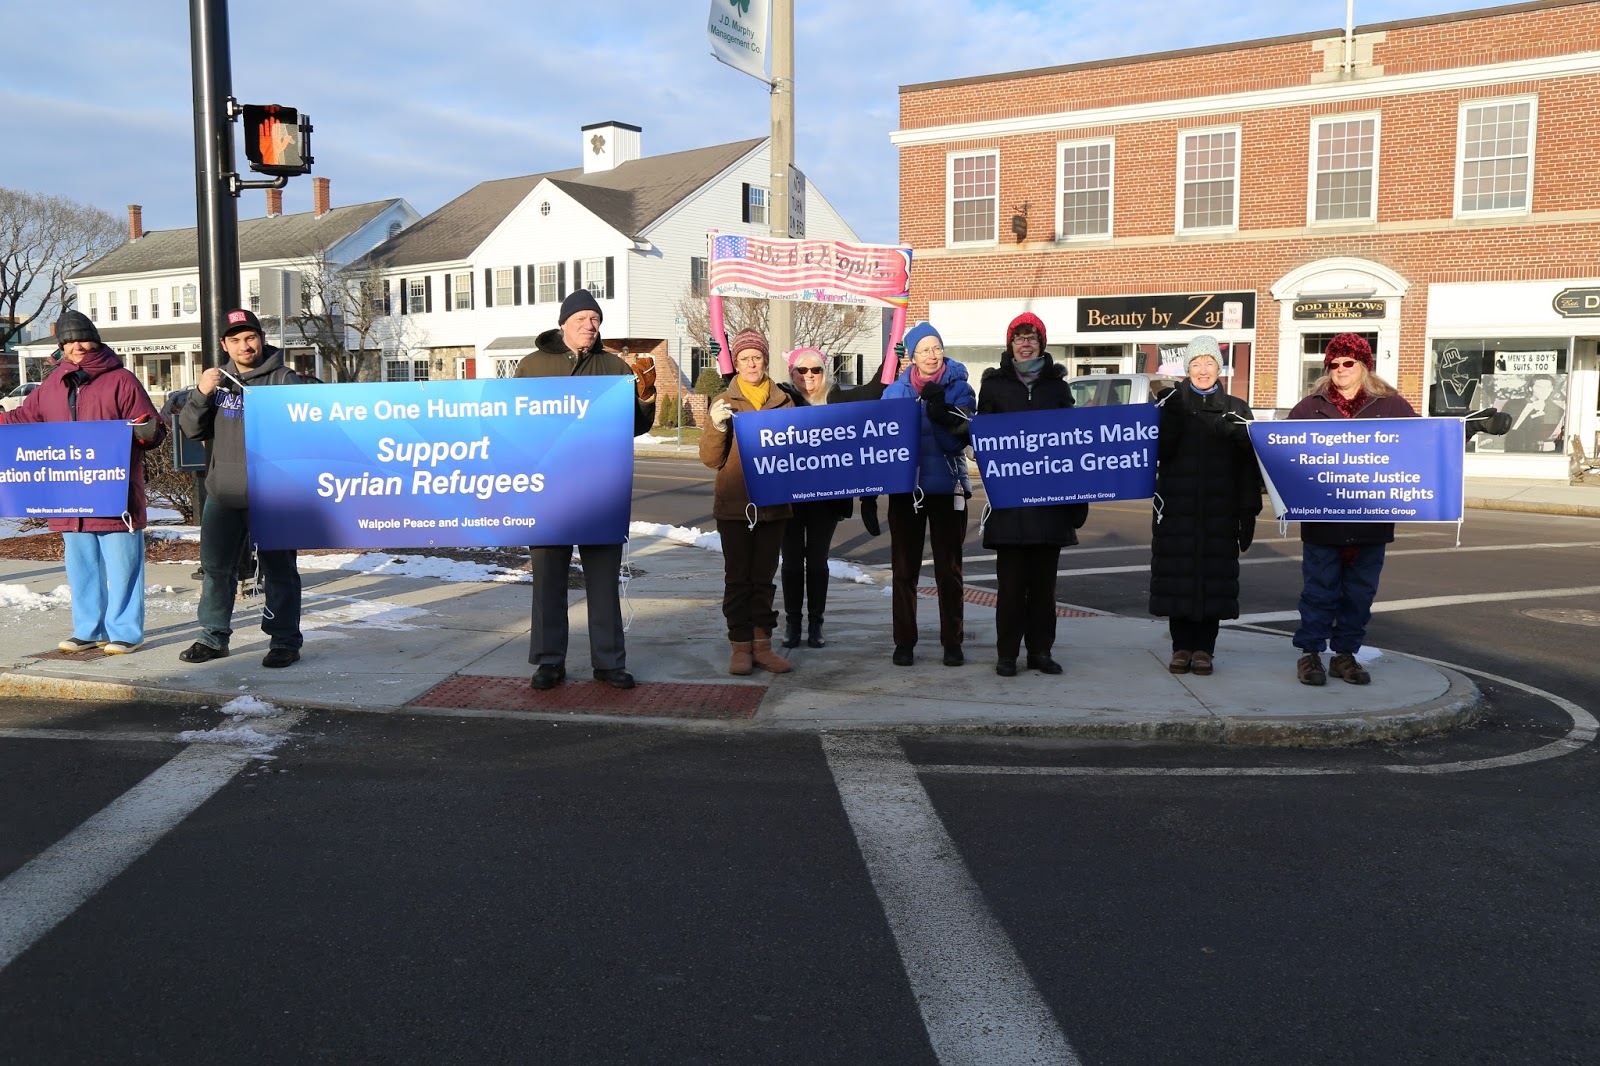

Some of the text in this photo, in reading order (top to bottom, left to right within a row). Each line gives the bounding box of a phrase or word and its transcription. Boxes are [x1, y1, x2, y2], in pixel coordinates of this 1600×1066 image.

[719, 14, 755, 40] J.D. Murphy
[710, 24, 762, 54] Management Co.
[793, 176, 801, 194] NO
[791, 196, 803, 215] TURN
[796, 219, 804, 236] RED
[753, 244, 780, 267] We
[1086, 294, 1224, 329] Beauty by Zan
[1295, 301, 1384, 313] ODD FELLOWS
[1384, 350, 1391, 359] 3
[1507, 353, 1556, 362] MEN'S & BOY'S
[1535, 362, 1549, 371] TOO
[215, 390, 245, 410] UMA
[287, 395, 590, 422] We Are One Human Family
[759, 419, 900, 448] Refugees Are
[972, 421, 1159, 453] Immigrants Make
[1268, 431, 1400, 446] Stand Together for:
[16, 445, 95, 461] America is a
[377, 435, 490, 468] Support
[1299, 453, 1339, 465] Racial
[1342, 453, 1390, 465] Justice
[753, 446, 910, 475] Welcome Here
[985, 448, 1149, 478] America Great!
[0, 466, 126, 484] ation of Immigrants
[1317, 471, 1370, 484] Climate
[1373, 471, 1421, 484] Justice
[317, 469, 545, 503] Syrian Refugees
[792, 491, 817, 501] Walpole
[816, 490, 834, 498] Peace
[846, 487, 865, 496] Justice
[865, 485, 884, 494] Group
[1335, 488, 1386, 499] Human
[1390, 487, 1434, 502] Rights
[1022, 496, 1047, 504] Walpole
[1047, 495, 1065, 503] Peace
[1077, 492, 1097, 500] Justice
[1097, 491, 1116, 499] Group
[26, 507, 42, 515] Walpole
[1290, 507, 1416, 516] Walpole Peace and Justice Group
[358, 515, 536, 531] Walpole Peace and Justice Group
